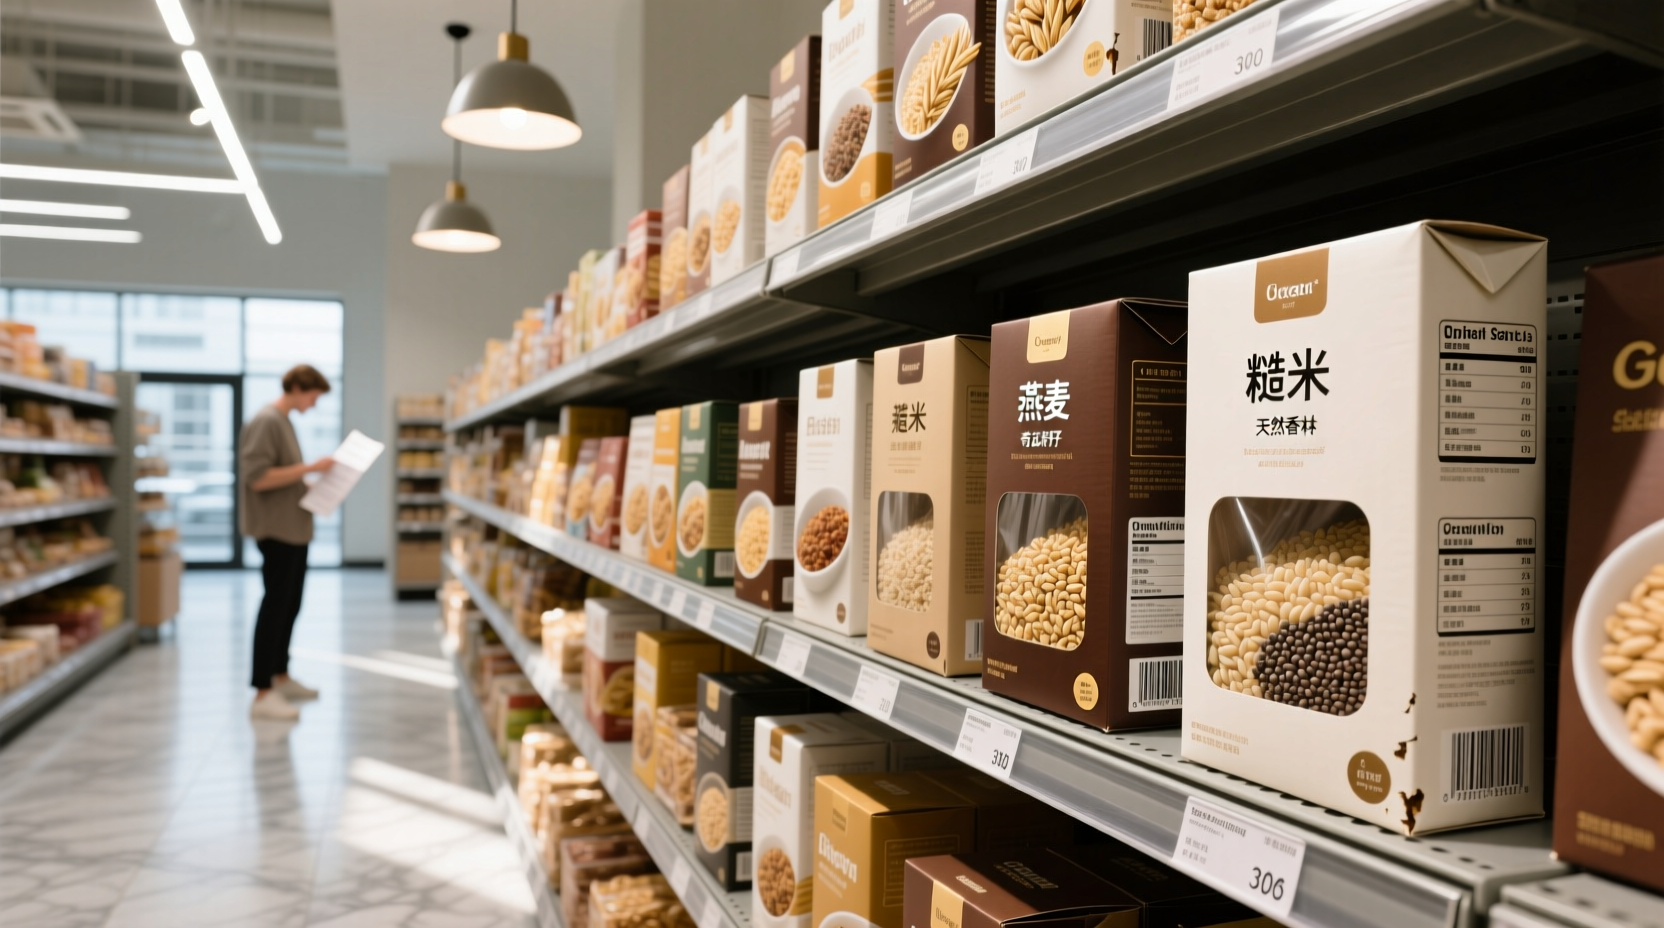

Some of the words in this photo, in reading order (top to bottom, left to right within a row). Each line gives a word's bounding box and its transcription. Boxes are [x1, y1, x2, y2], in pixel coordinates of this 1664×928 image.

[1234, 47, 1263, 75] 300
[1245, 347, 1330, 404] 糙米
[1017, 379, 1071, 423] 燕麦
[1249, 866, 1285, 901] 306
